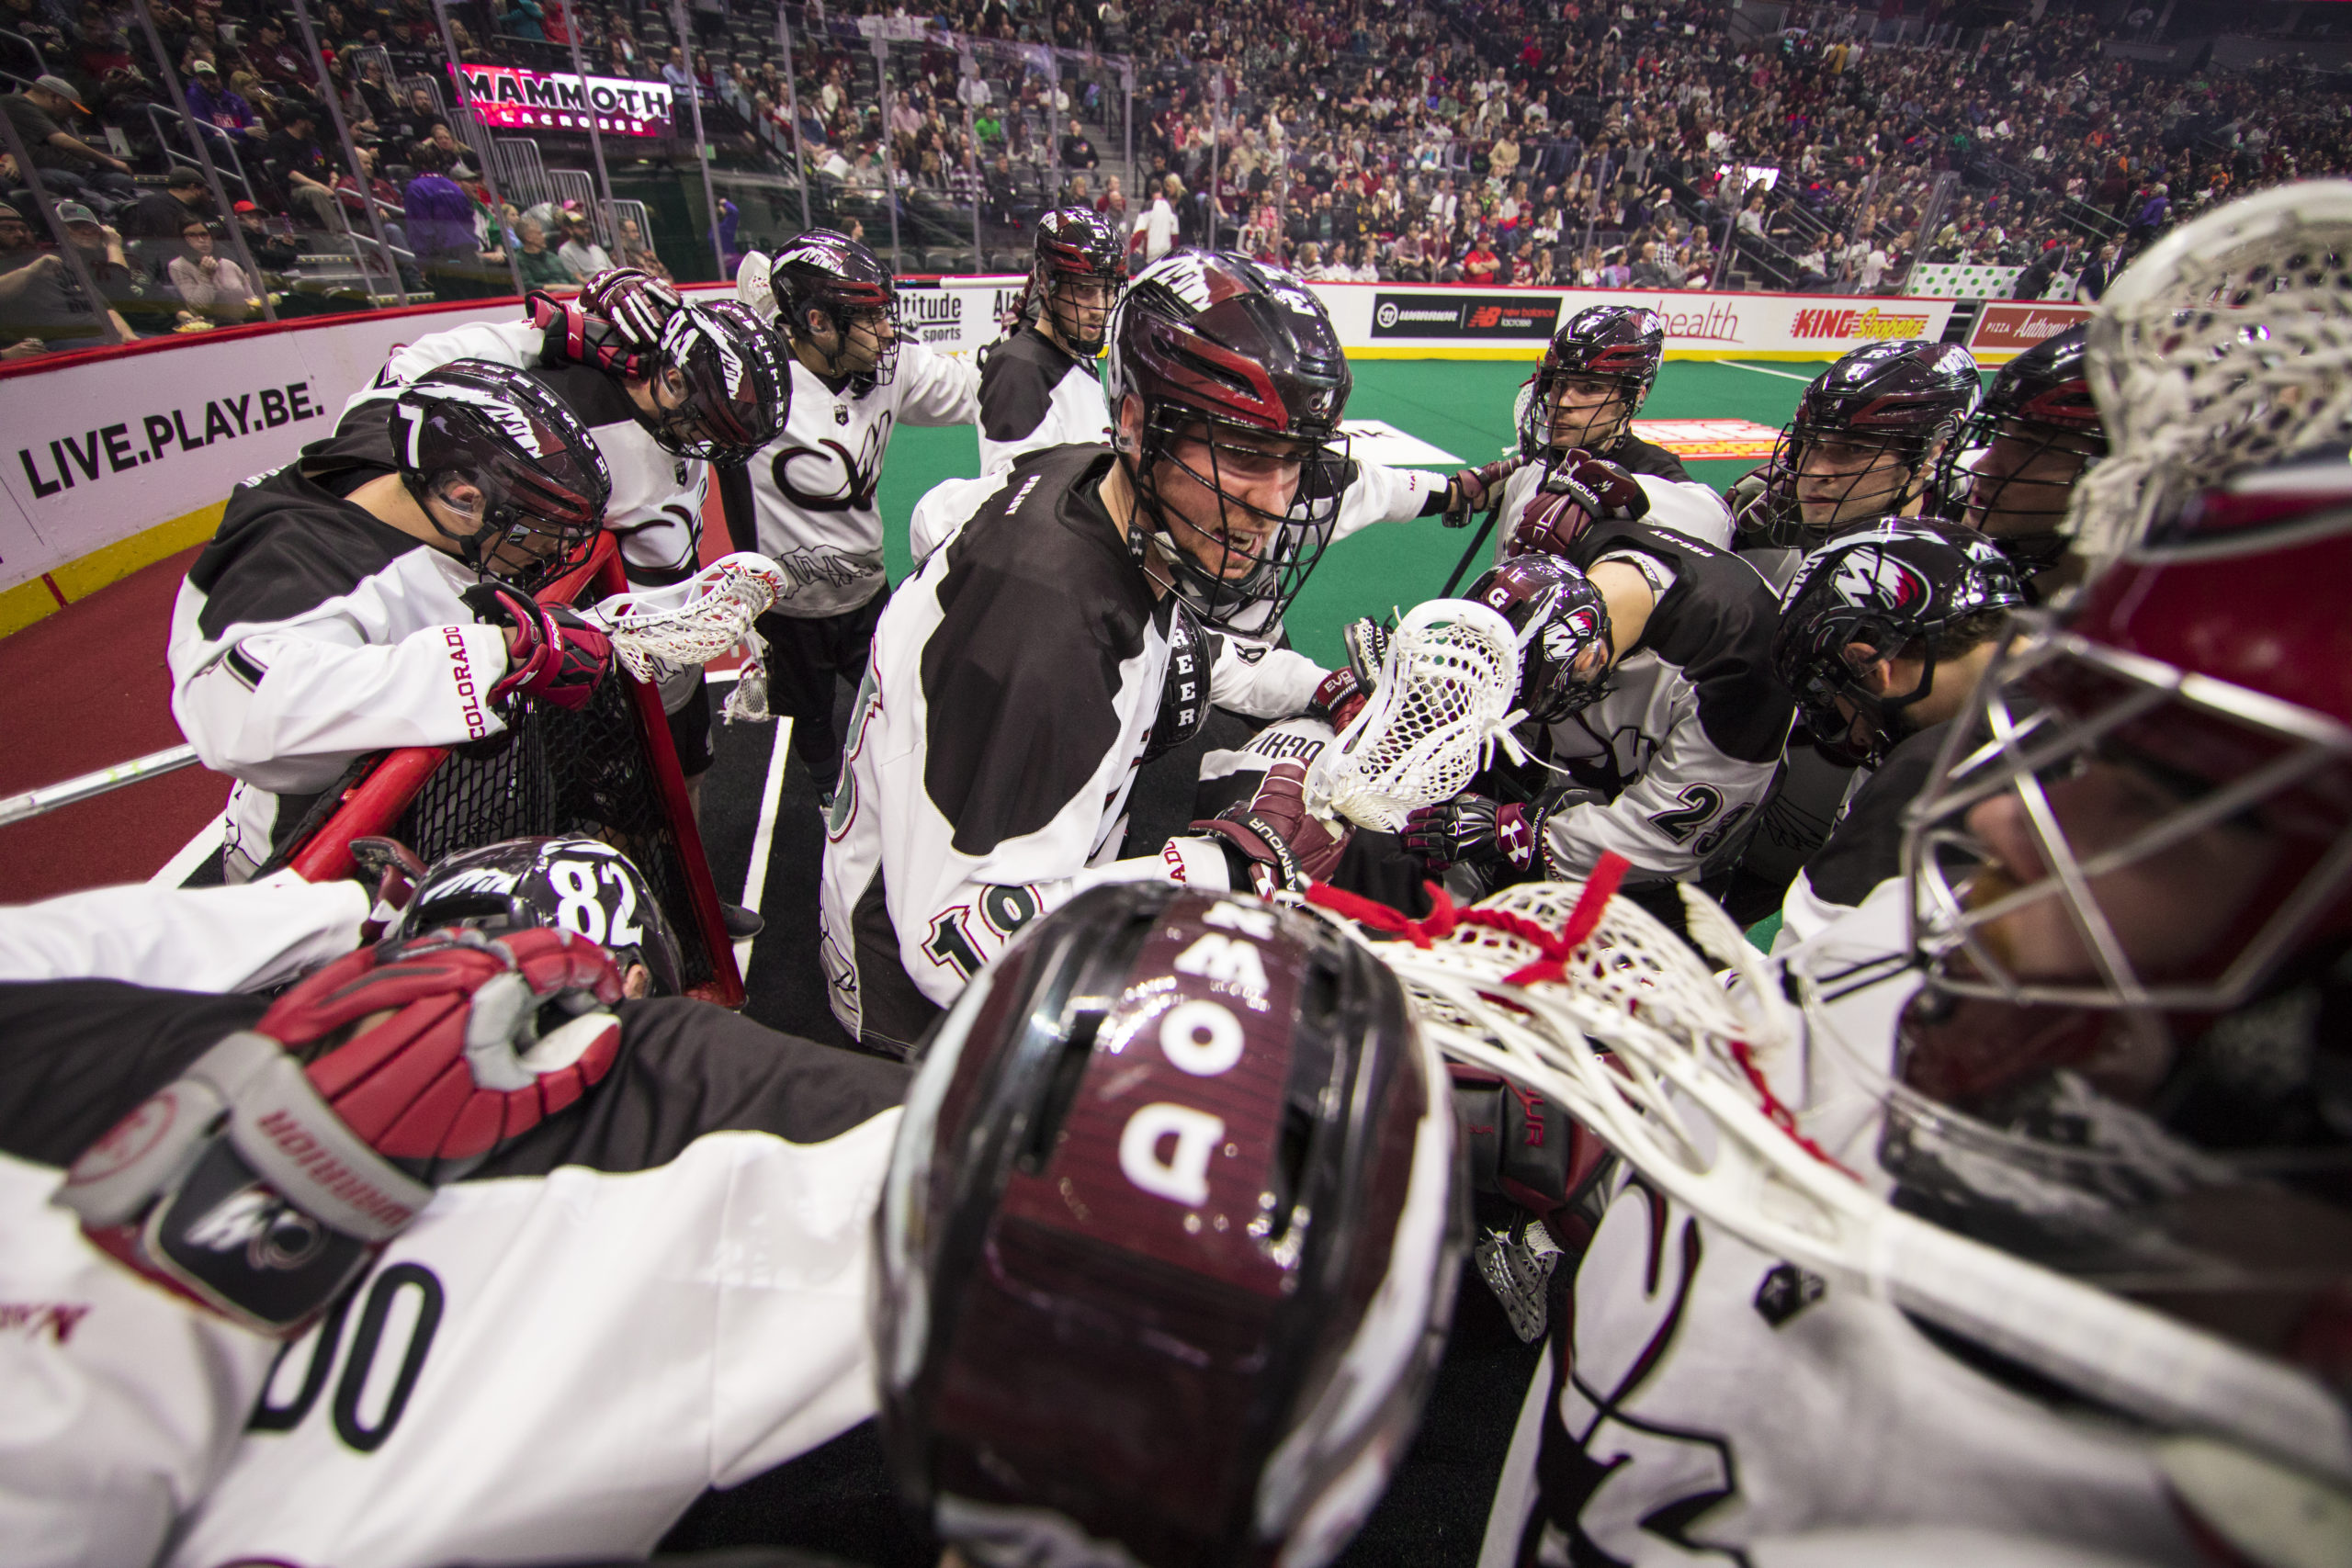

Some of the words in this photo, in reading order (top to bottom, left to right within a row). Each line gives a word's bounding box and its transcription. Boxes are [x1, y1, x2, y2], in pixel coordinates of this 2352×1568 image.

[462, 71, 671, 118] MAMMOTH
[501, 111, 644, 132] LACROSSE
[922, 328, 961, 343] sports
[1657, 299, 1739, 337] health
[1792, 309, 1856, 338] KING
[1852, 307, 1924, 343] Soopers
[1985, 321, 2010, 333] PIZZA
[18, 382, 325, 499] LIVE.PLAY.BE.
[1555, 473, 1600, 505] ARMOUR
[443, 626, 486, 741] COLORADO
[1324, 670, 1352, 694] EVO
[1249, 818, 1297, 892] ARMOUR
[547, 860, 643, 947] 82
